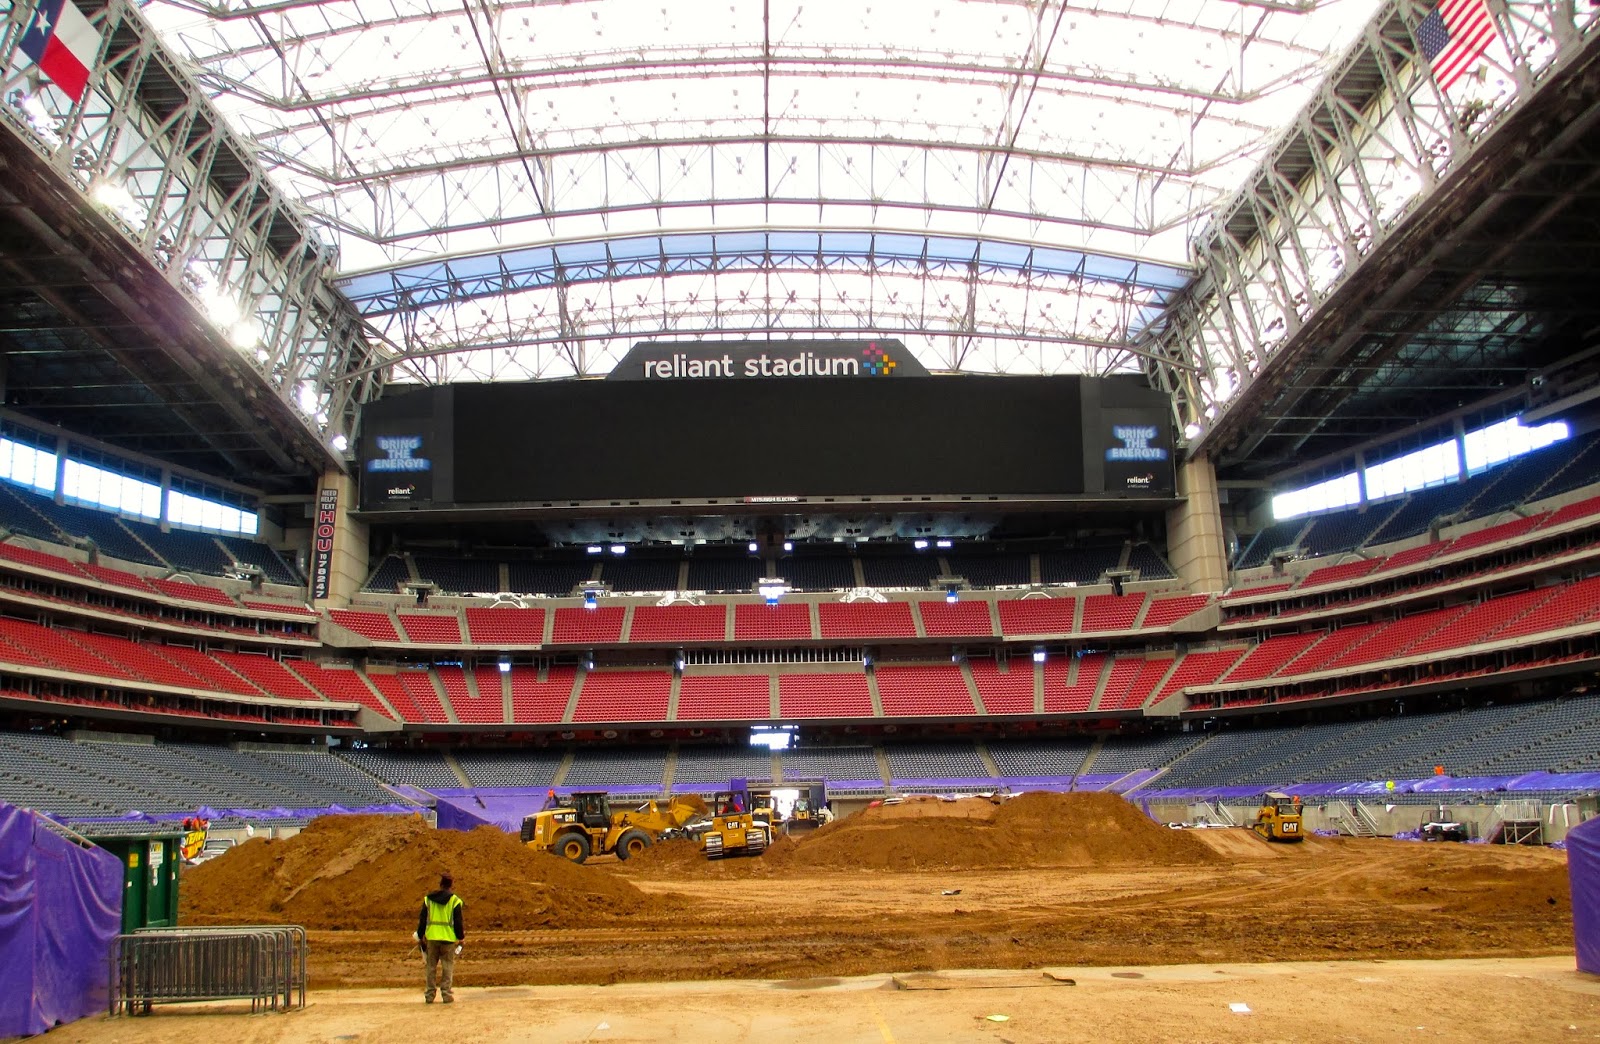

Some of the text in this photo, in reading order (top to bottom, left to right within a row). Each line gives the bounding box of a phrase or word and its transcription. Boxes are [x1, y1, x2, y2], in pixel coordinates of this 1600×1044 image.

[644, 352, 859, 378] reliant stadium
[1118, 429, 1153, 439] BRING
[382, 440, 417, 449] BRING
[1124, 438, 1147, 448] THE
[388, 449, 411, 459] THE
[1112, 448, 1160, 458] ENERGY!
[375, 459, 423, 469] ENERGY!
[1127, 476, 1148, 484] reliant
[388, 487, 410, 495] reliant
[318, 511, 335, 552] HOU
[564, 813, 576, 822] CAT
[727, 822, 739, 830] CAT
[1283, 823, 1298, 832] CAT
